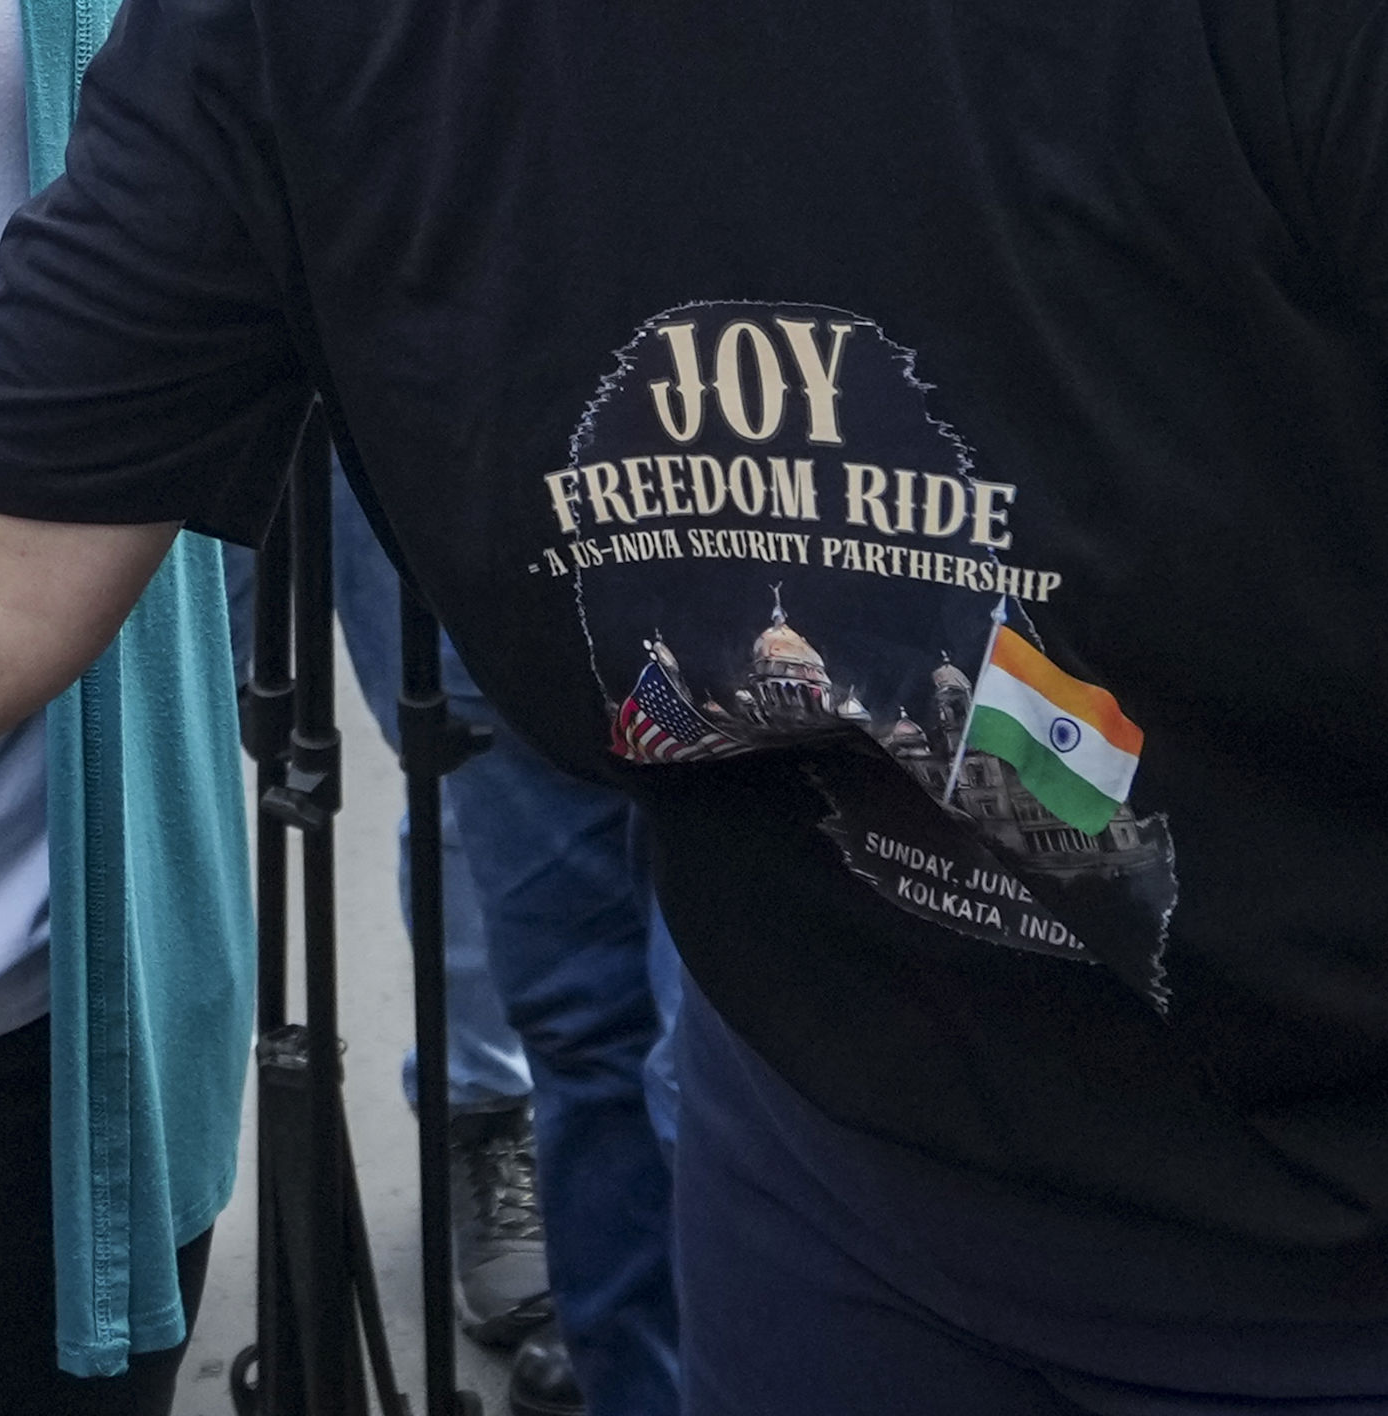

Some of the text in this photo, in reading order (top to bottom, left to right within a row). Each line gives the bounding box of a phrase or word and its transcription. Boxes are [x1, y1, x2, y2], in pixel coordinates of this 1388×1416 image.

[649, 317, 854, 444] JOY
[543, 453, 1017, 551] FREEDOM RIDE
[542, 547, 569, 577] A
[568, 528, 684, 569] US-INDIA
[687, 528, 811, 565] SECURITY
[1020, 912, 1085, 951] INDI
